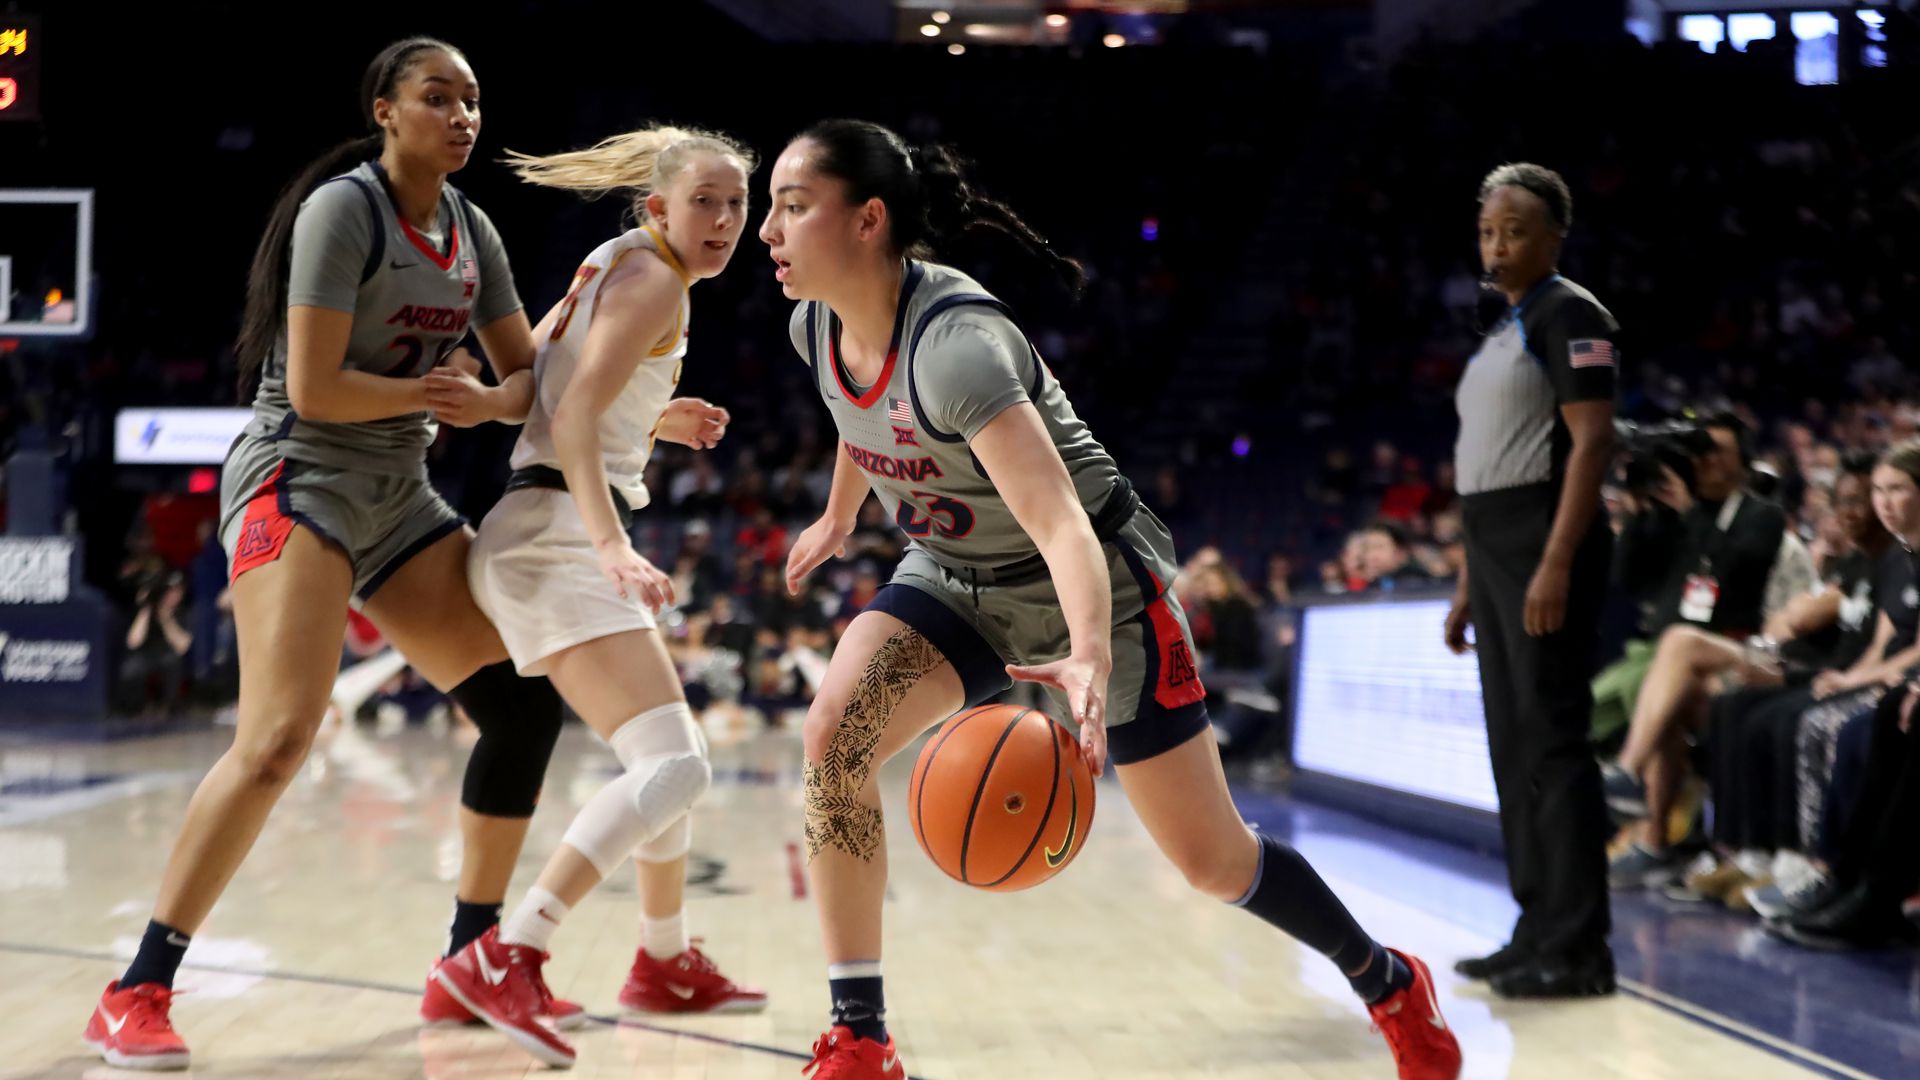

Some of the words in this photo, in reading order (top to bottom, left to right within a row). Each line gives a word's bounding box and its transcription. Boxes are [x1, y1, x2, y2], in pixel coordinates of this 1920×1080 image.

[384, 303, 471, 333] ARIZON
[240, 519, 272, 558] A
[1168, 638, 1196, 688] A
